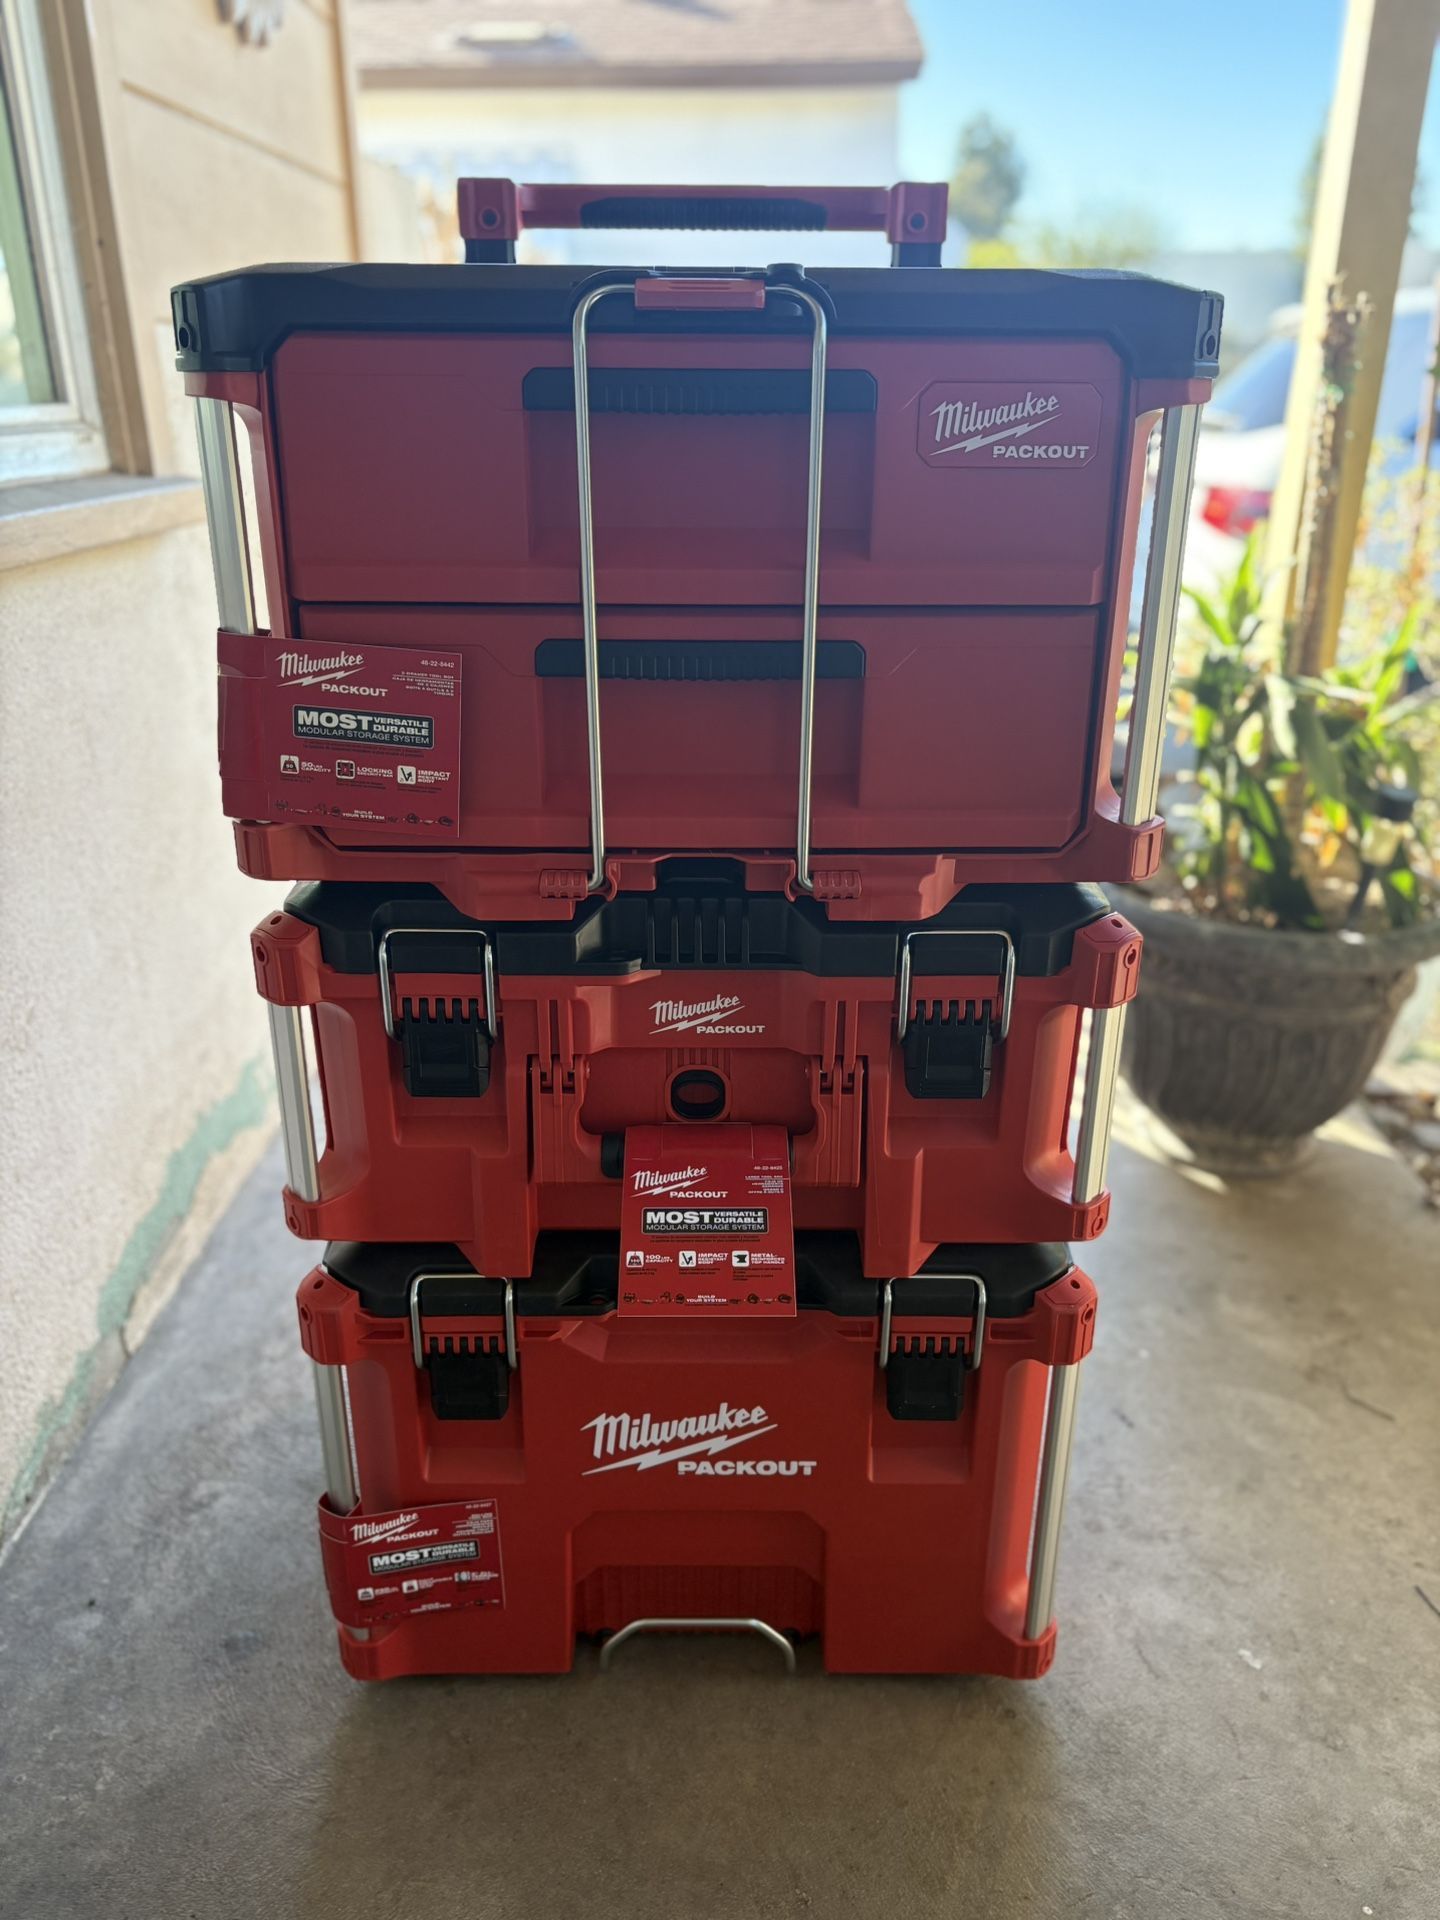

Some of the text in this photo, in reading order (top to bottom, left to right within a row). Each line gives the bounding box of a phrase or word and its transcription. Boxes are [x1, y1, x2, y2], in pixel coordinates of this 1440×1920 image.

[929, 392, 1060, 442] Milwaukee
[992, 445, 1090, 459] PACKOUT
[275, 651, 364, 678] Milwaukee
[321, 683, 388, 697] PACKOUT
[297, 710, 373, 731] MOST
[373, 716, 429, 728] VERSATILE
[298, 726, 430, 744] MODULAR STORAGE SYSTEM
[373, 723, 429, 736] DURABLE
[357, 766, 393, 775] LOCKING
[417, 770, 451, 778] IMPACT
[648, 994, 740, 1026] Milwaukee
[696, 1025, 766, 1034] PACKOUT
[630, 1166, 708, 1190] Milwaukee
[669, 1191, 729, 1199] PACKOUT
[646, 1211, 714, 1224] MOST
[580, 1402, 768, 1459] Milwaukee
[677, 1460, 817, 1475] PACKOUT
[349, 1513, 419, 1541] Milwaukee
[386, 1528, 439, 1543] PACKOUT
[372, 1548, 432, 1567] MOST
[431, 1546, 475, 1556] DURABLE
